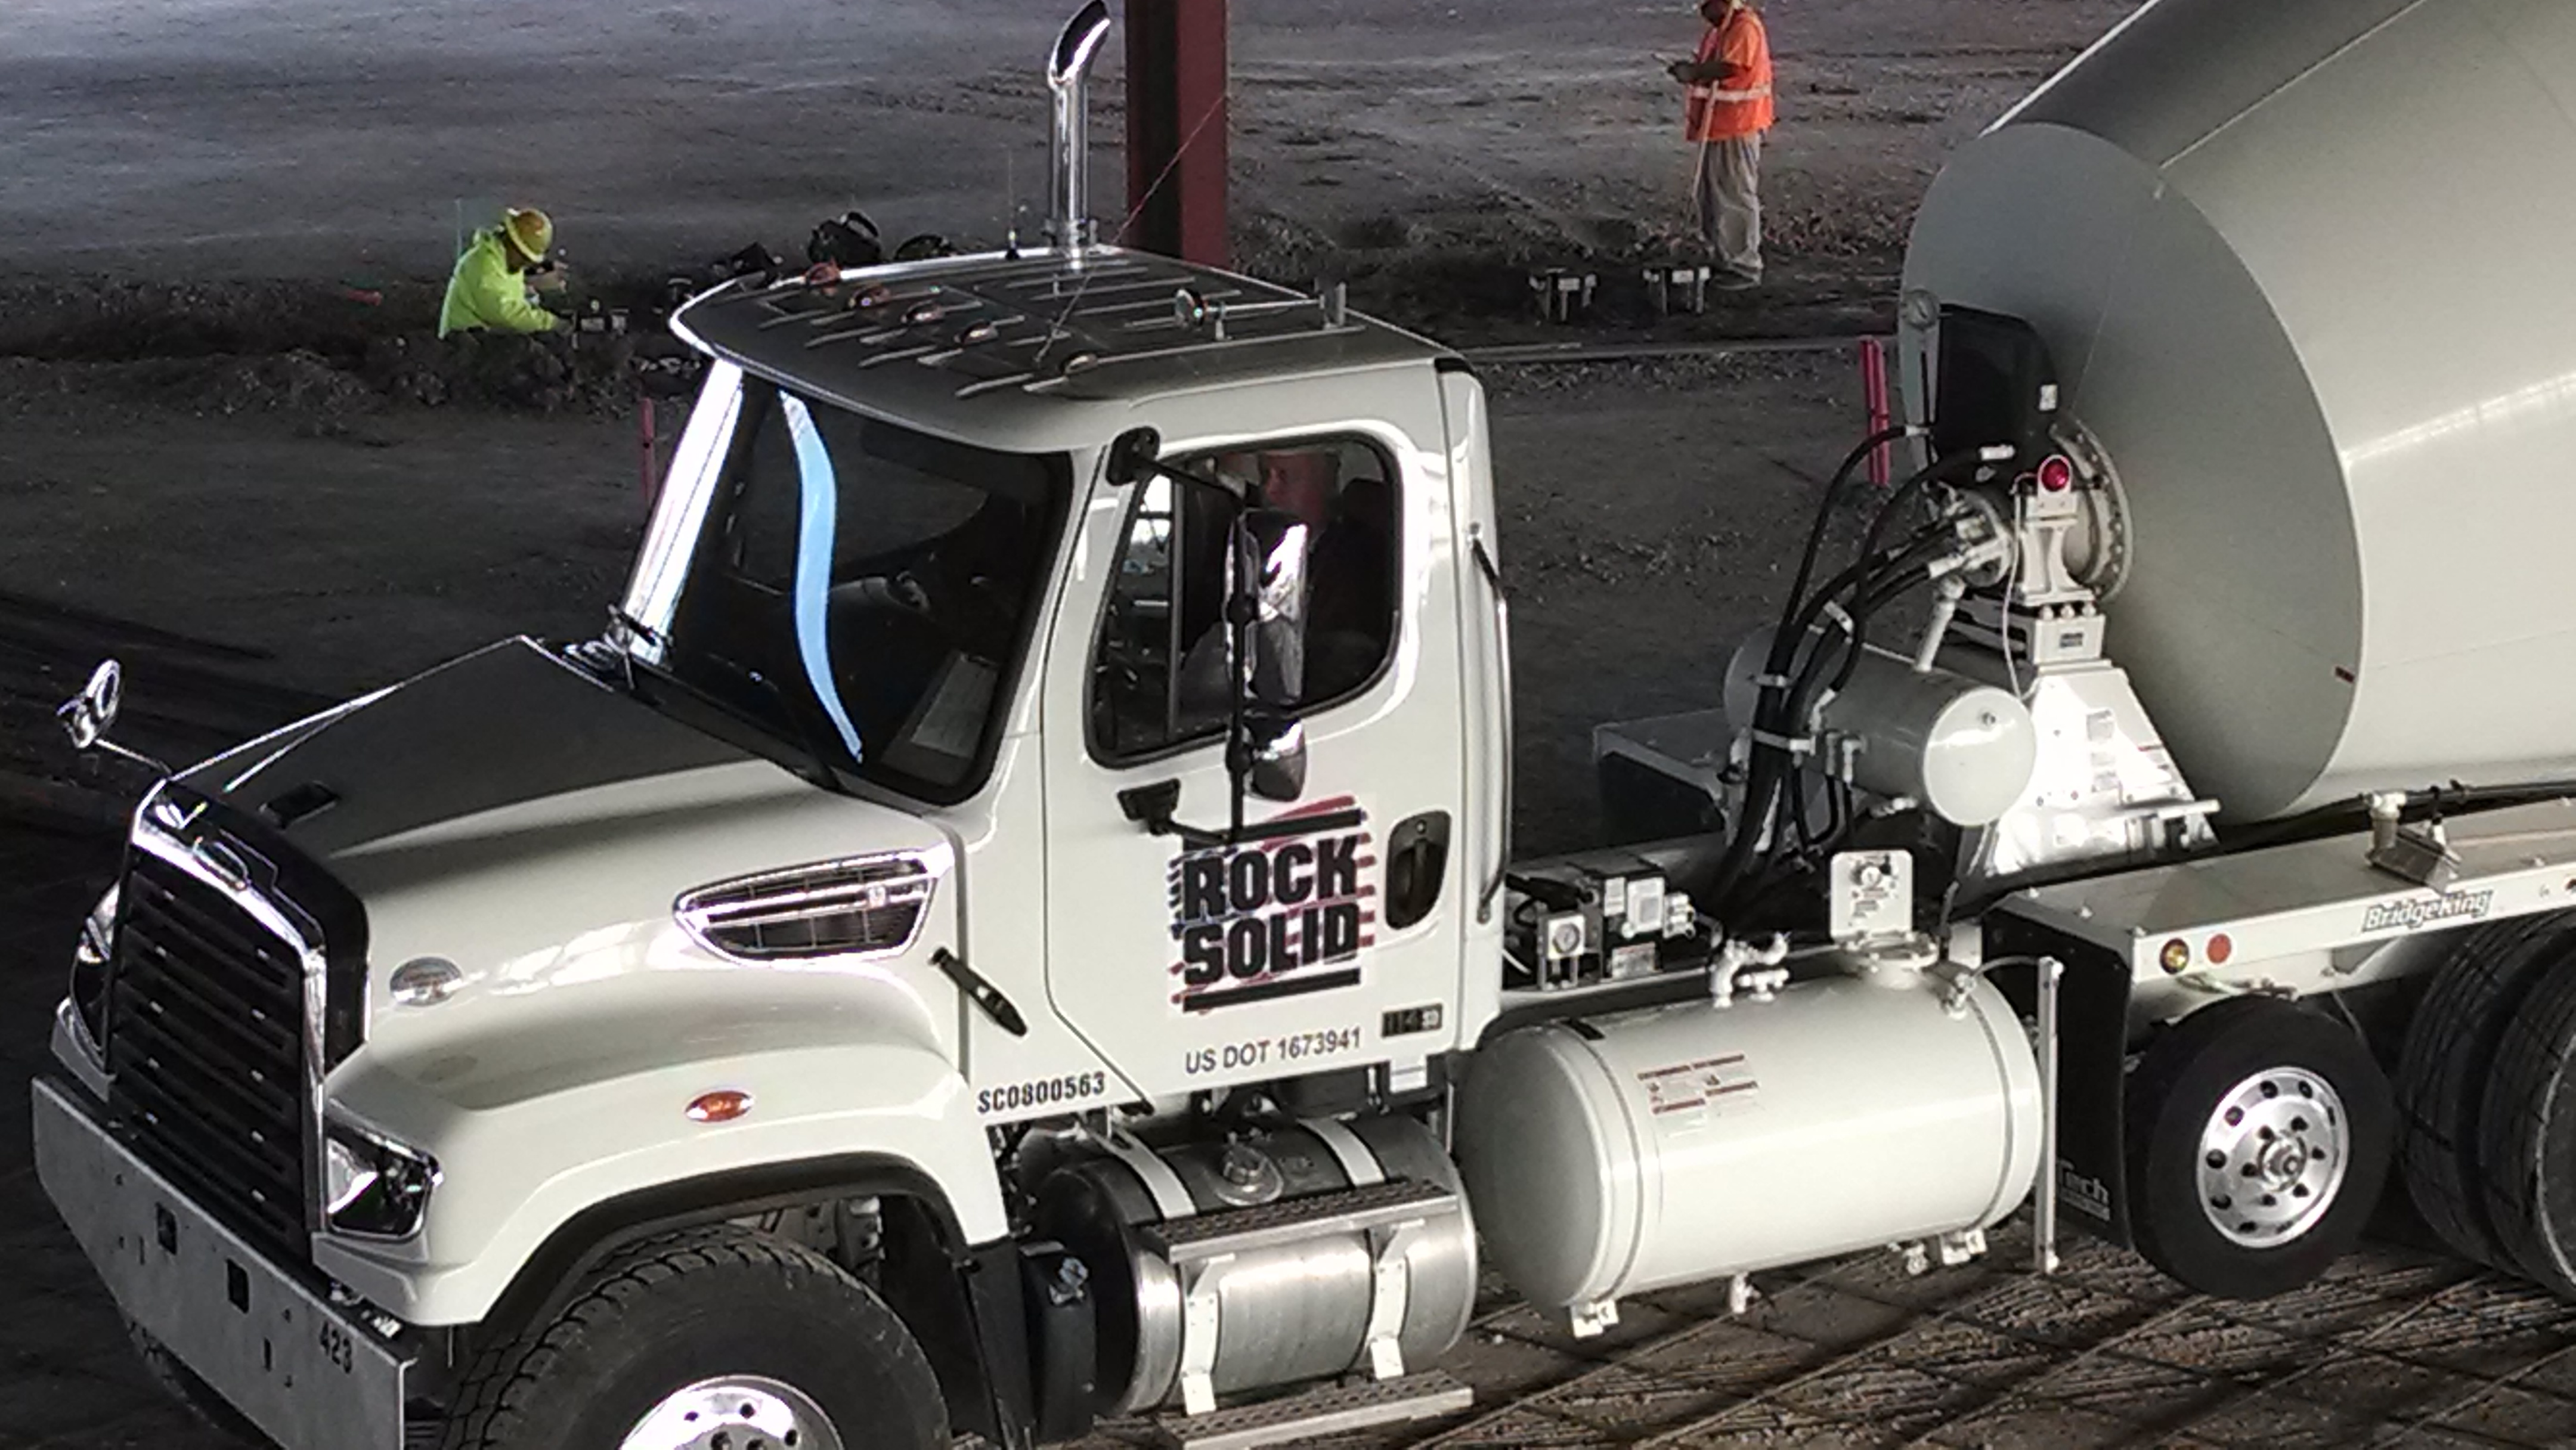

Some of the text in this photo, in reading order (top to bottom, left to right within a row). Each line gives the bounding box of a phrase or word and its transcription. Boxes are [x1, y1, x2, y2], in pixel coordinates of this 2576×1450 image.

[1183, 834, 1358, 921] ROCK
[1184, 902, 1360, 986] SOLID
[1185, 1026, 1361, 1074] US DOT 1673941
[977, 1071, 1106, 1114] SC0800563
[320, 1319, 352, 1375] 423
